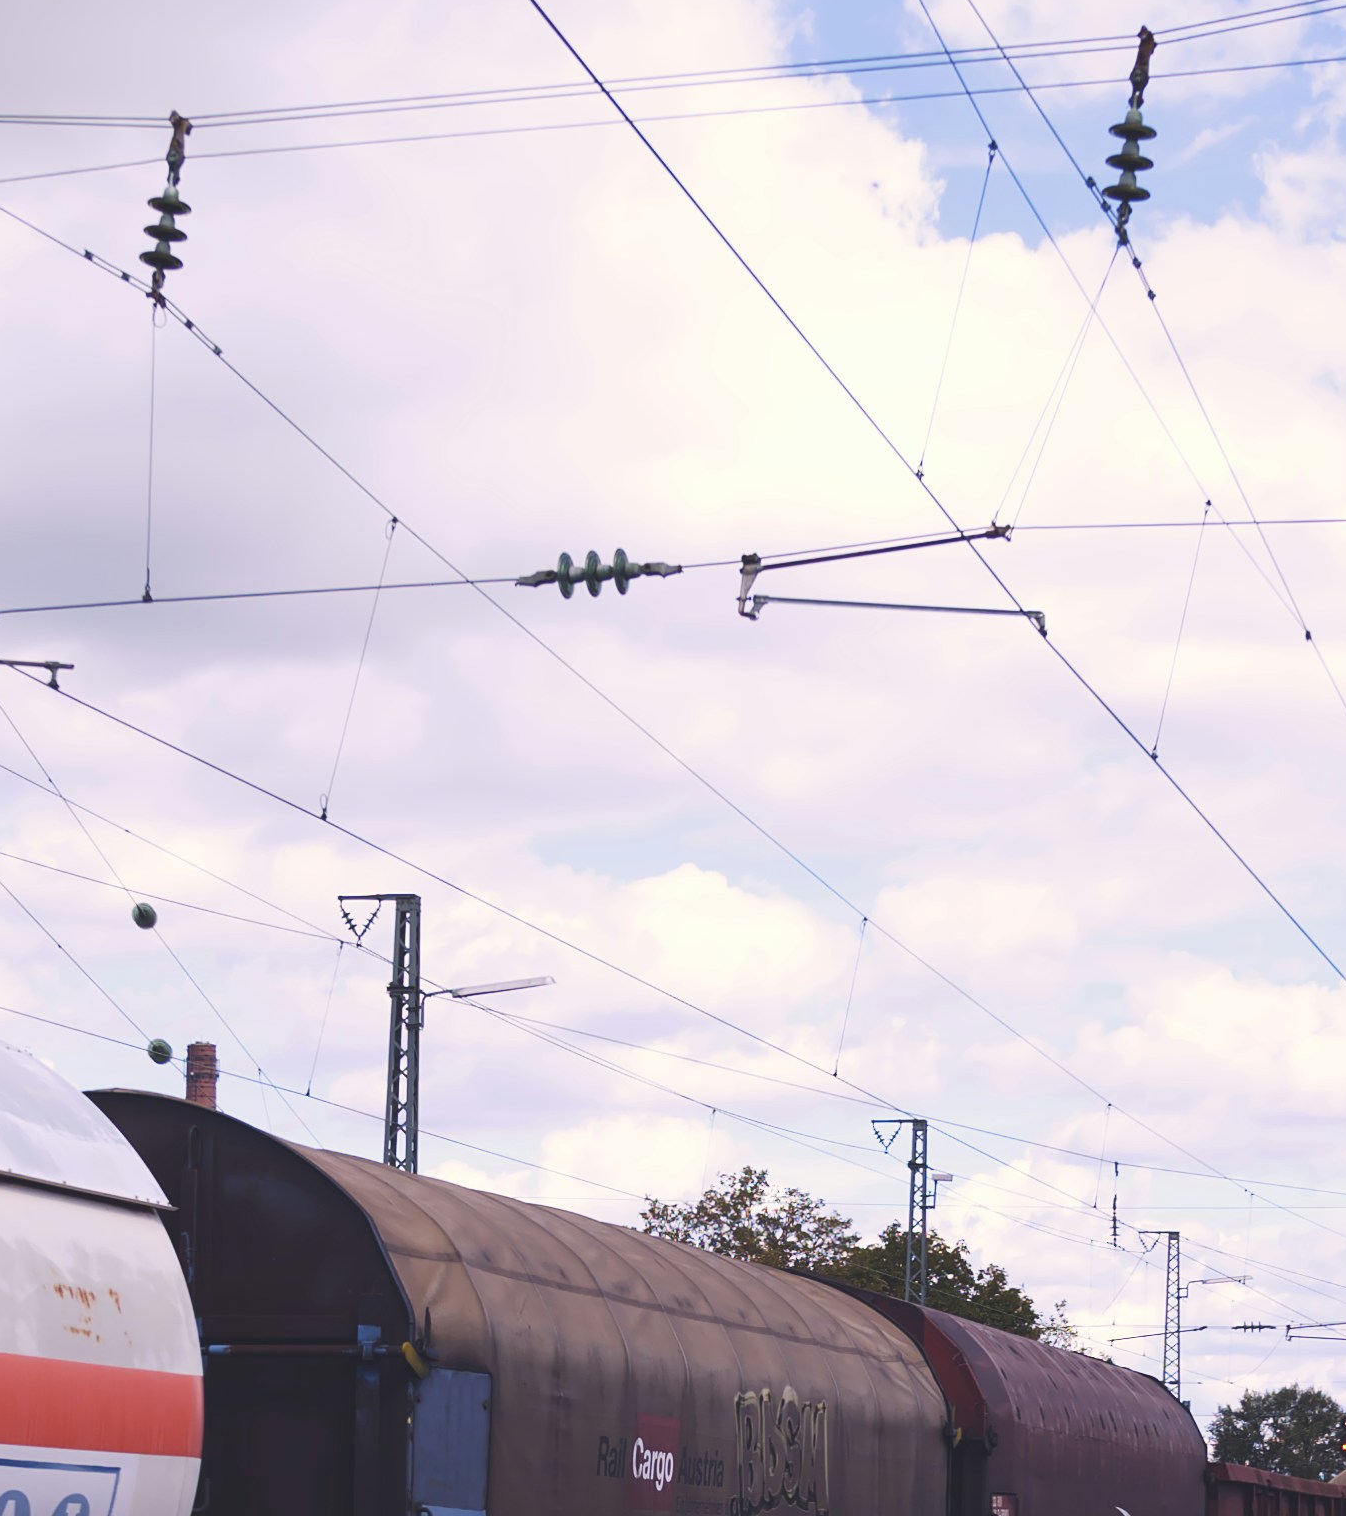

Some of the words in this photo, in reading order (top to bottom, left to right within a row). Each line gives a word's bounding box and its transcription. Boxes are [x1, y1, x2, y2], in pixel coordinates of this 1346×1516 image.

[597, 1435, 628, 1478] Rail
[632, 1436, 674, 1492] Cargo
[676, 1446, 725, 1488] Austria
